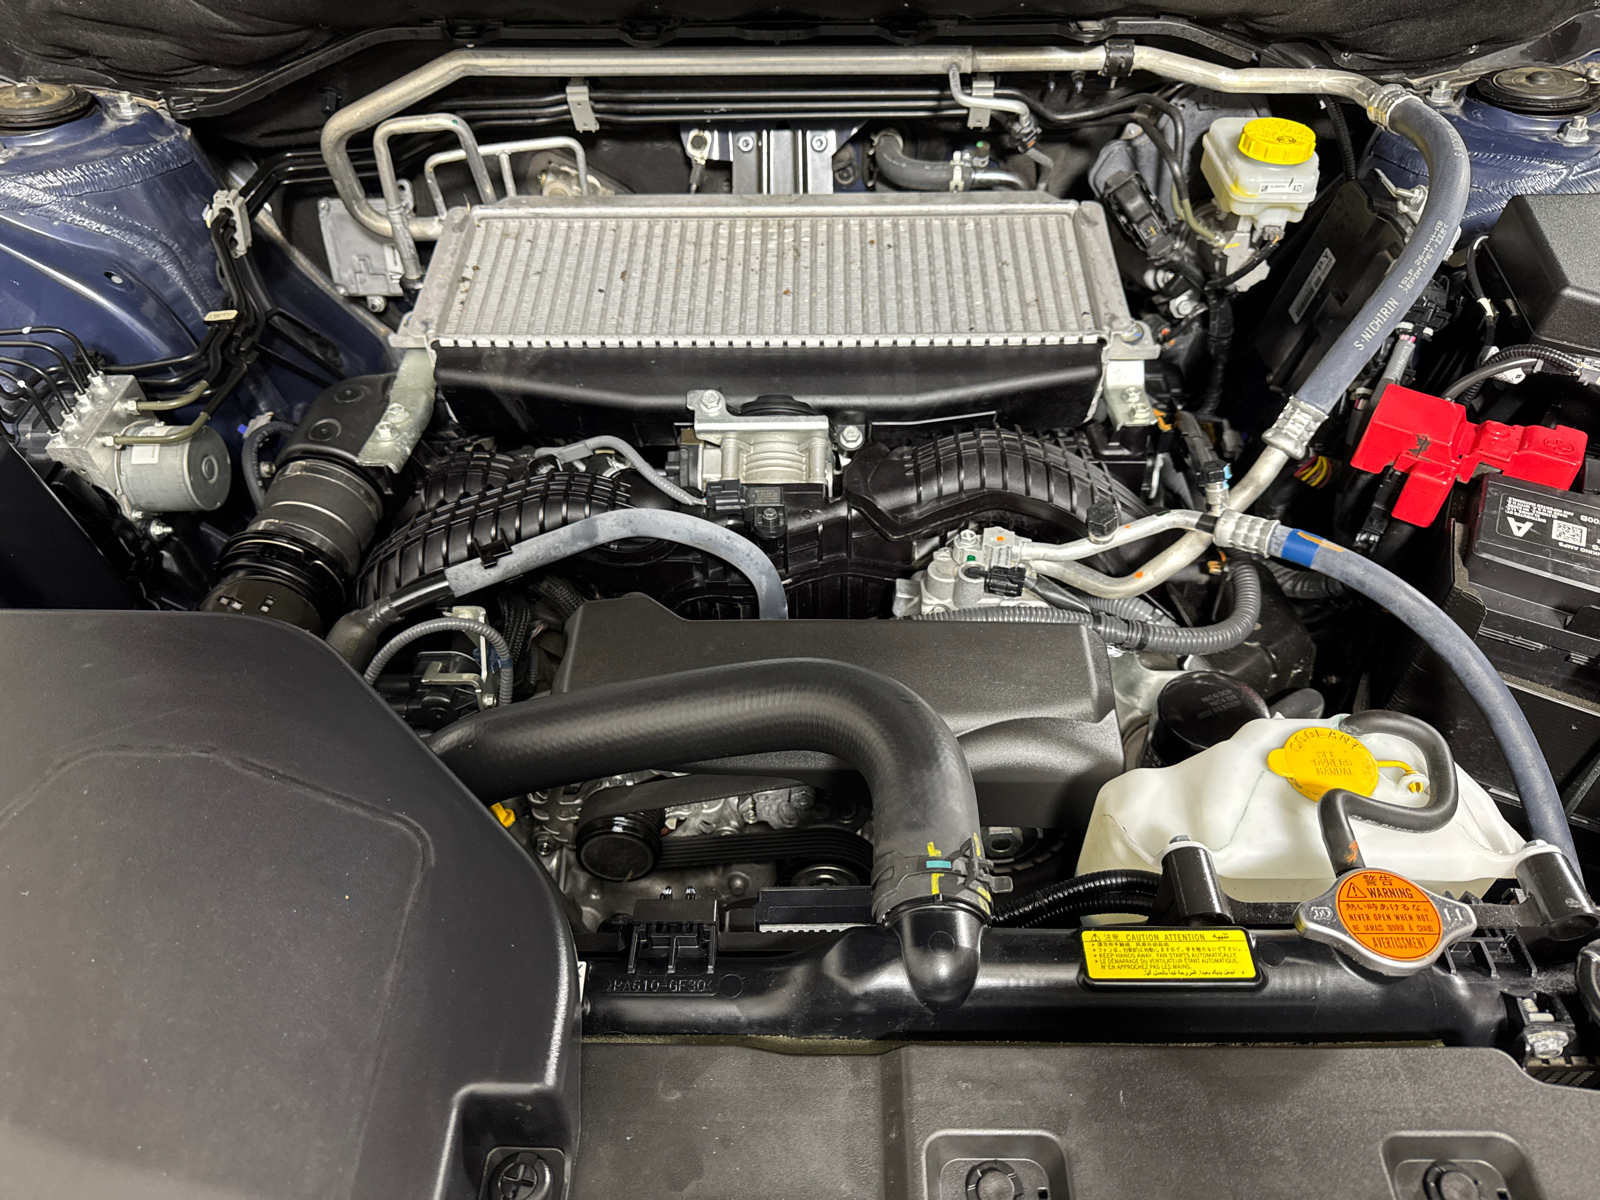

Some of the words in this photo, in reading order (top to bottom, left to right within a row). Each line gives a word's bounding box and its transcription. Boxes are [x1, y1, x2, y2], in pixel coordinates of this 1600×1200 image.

[1398, 268, 1414, 290] 15LP
[1558, 542, 1579, 550] AMPS
[1290, 729, 1362, 750] COOLANT
[1316, 768, 1356, 776] MANUAL
[1363, 874, 1394, 886] 警告
[1366, 888, 1414, 899] WARNING
[1408, 923, 1414, 932] À
[1212, 932, 1229, 941] تنبيه
[1372, 937, 1428, 949] AVERTISSMENT
